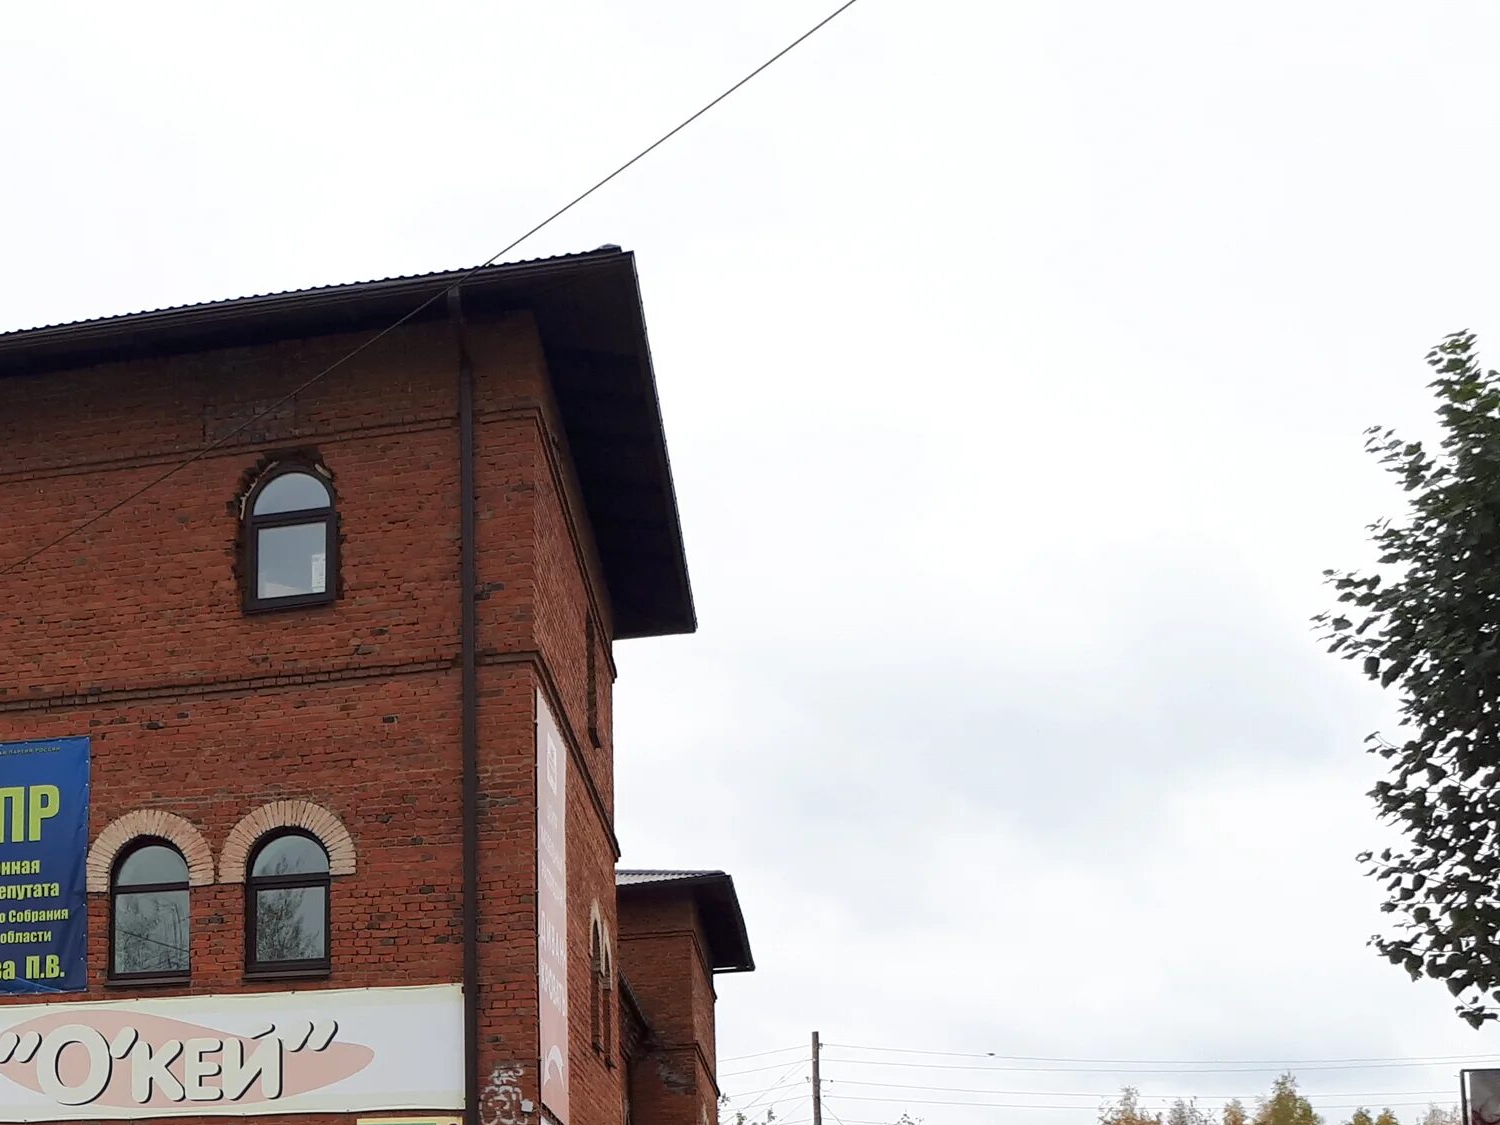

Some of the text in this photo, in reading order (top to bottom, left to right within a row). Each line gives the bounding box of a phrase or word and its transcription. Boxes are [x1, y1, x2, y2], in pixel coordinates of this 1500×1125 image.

[8, 907, 69, 924] Собрания
[0, 930, 52, 945] области
[25, 954, 66, 980] П.В.
